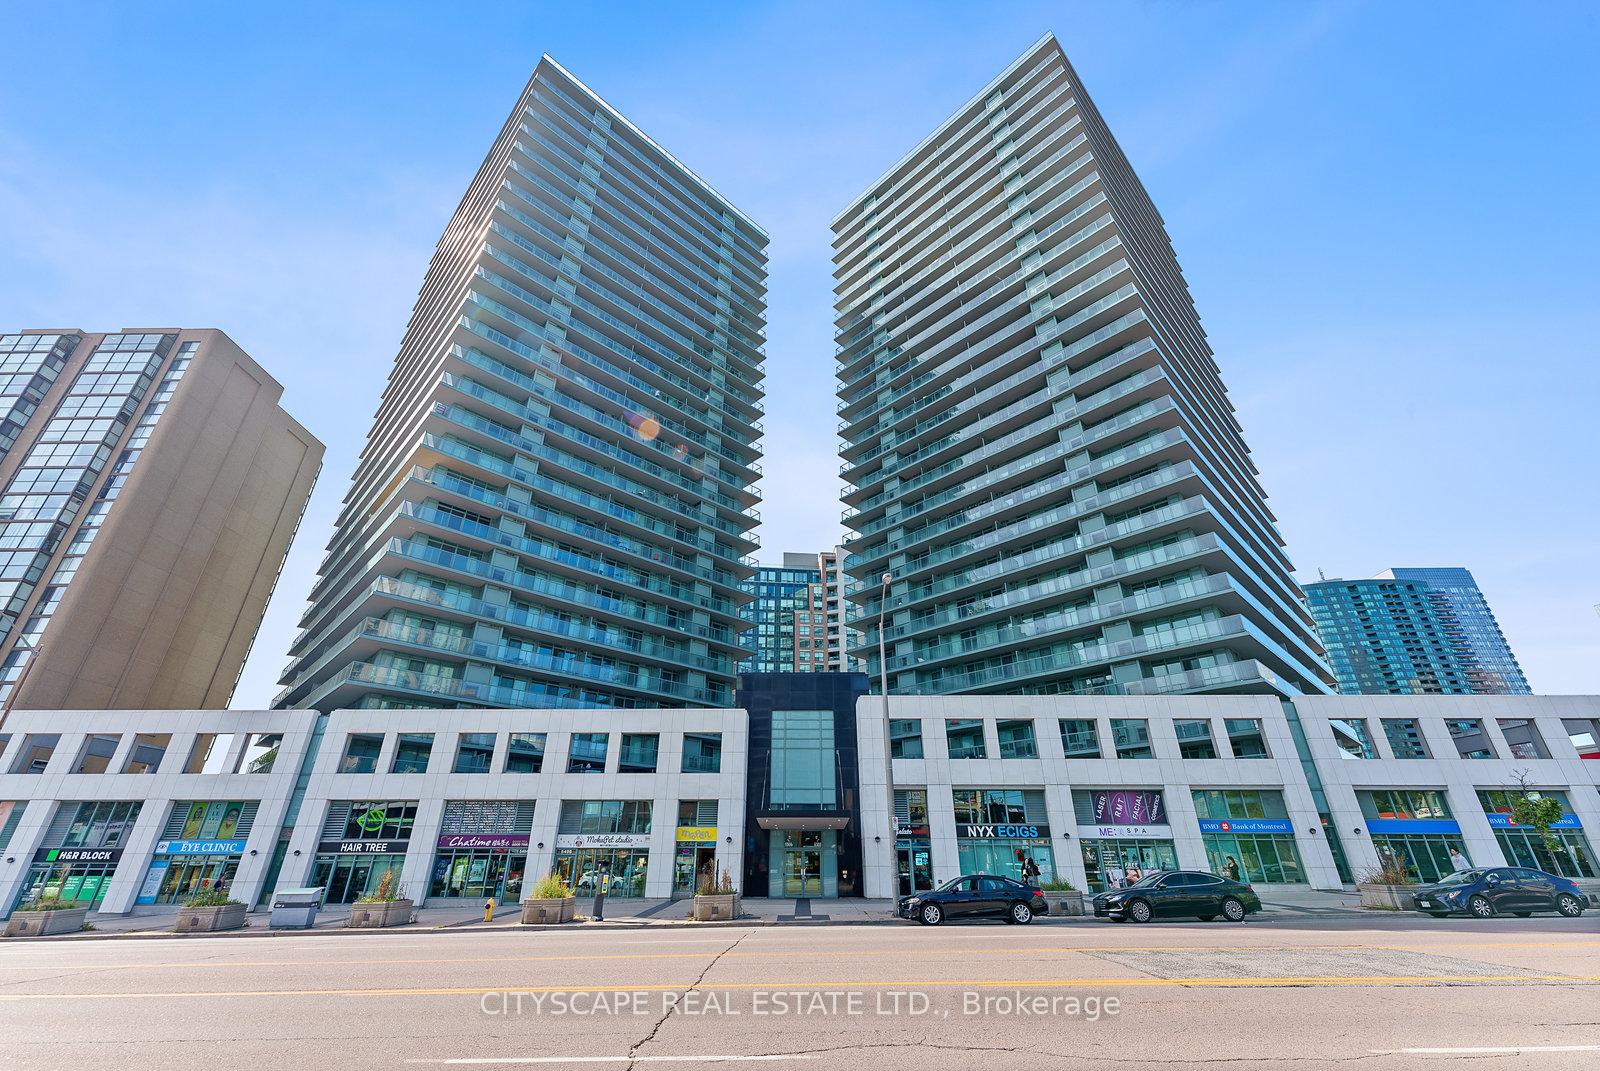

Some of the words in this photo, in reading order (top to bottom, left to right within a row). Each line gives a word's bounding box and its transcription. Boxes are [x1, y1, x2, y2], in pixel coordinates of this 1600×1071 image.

[1096, 795, 1106, 819] LASER
[1114, 798, 1124, 818] RMT
[1132, 795, 1142, 820] FACIAL
[967, 826, 994, 837] NYX
[997, 826, 1038, 837] ECIGS
[449, 836, 491, 847] Chatime
[180, 843, 202, 852] EYE
[202, 843, 237, 852] CLINIC
[340, 843, 363, 852] HAIR
[365, 843, 388, 852] TREE
[59, 851, 80, 860] H&R
[80, 851, 112, 860] BLOCK
